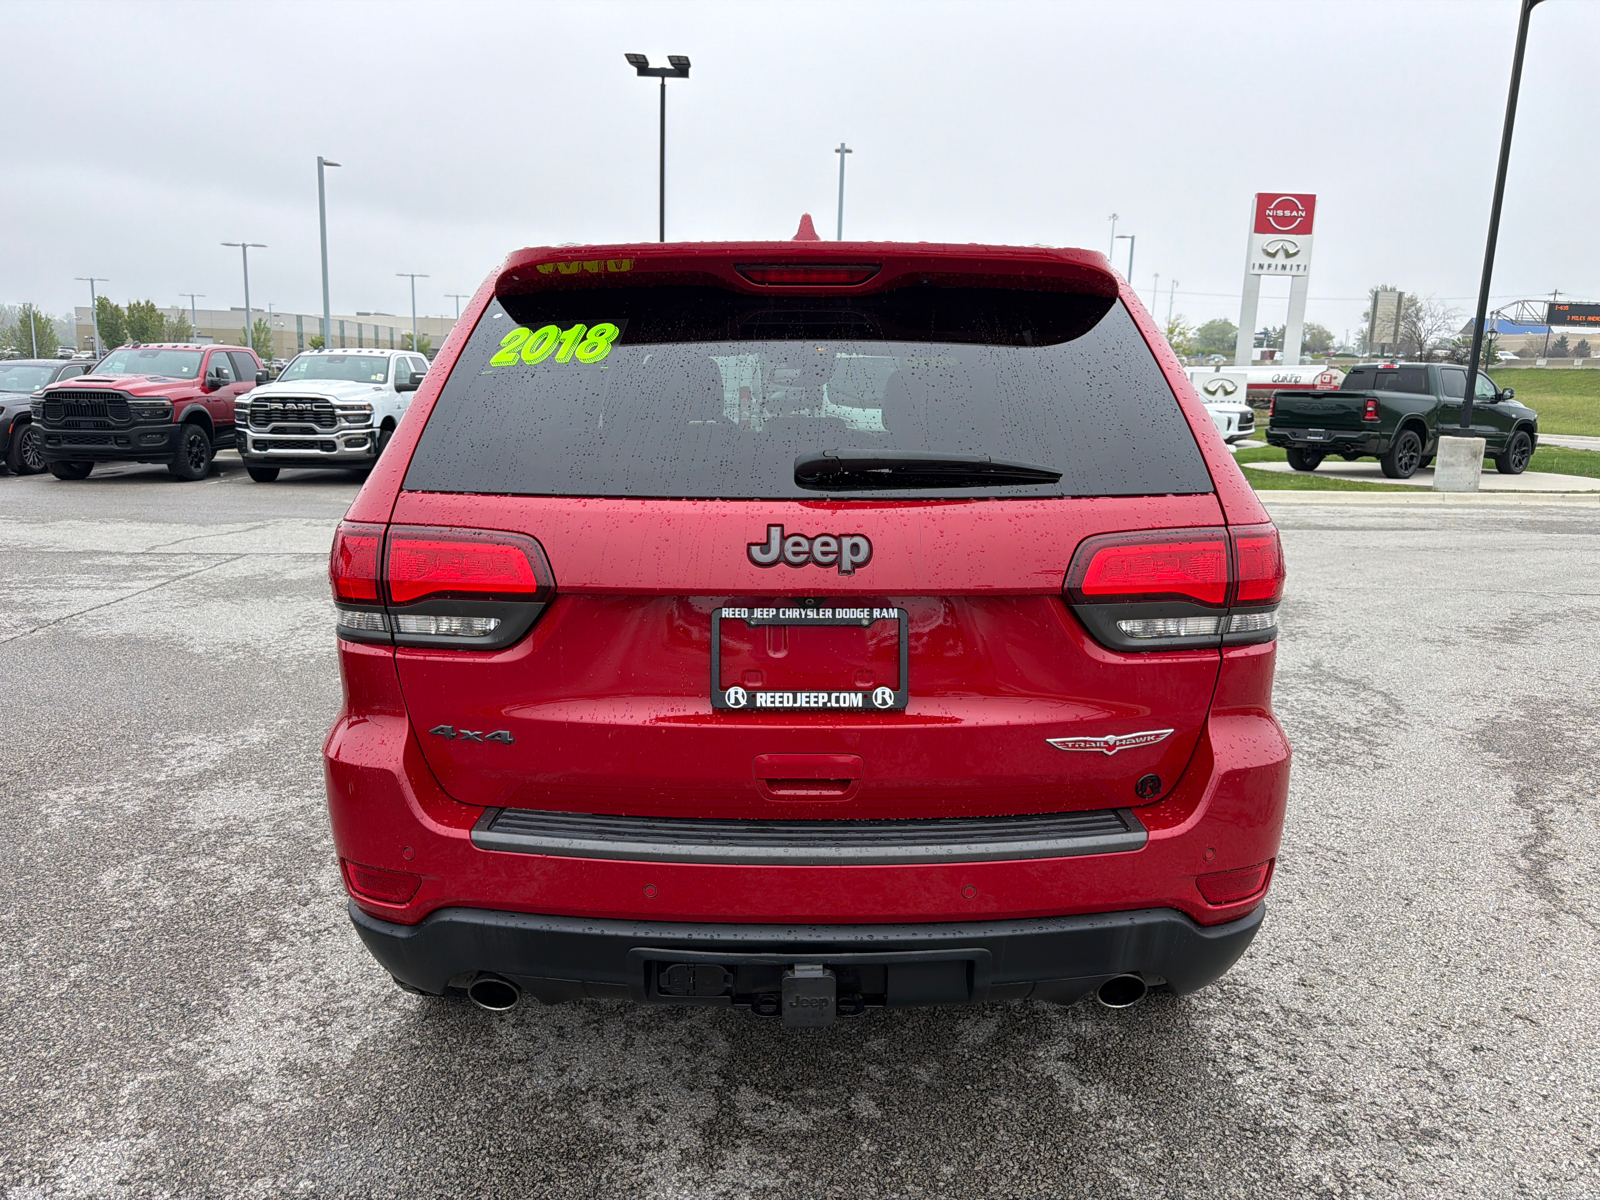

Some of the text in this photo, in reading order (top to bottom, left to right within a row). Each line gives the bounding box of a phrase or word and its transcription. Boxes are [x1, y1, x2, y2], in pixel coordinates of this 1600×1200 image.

[1265, 209, 1306, 217] NISSAN
[1252, 262, 1307, 272] INFINITI
[489, 322, 620, 367] 2018
[269, 402, 312, 411] RAM
[747, 524, 873, 576] Jeep
[721, 607, 898, 619] REED JEEP CHRYSLER DODGE RAM
[756, 692, 863, 708] REEDJEEP.COM
[1116, 735, 1156, 746] HAWK
[788, 995, 830, 1011] Jeep
